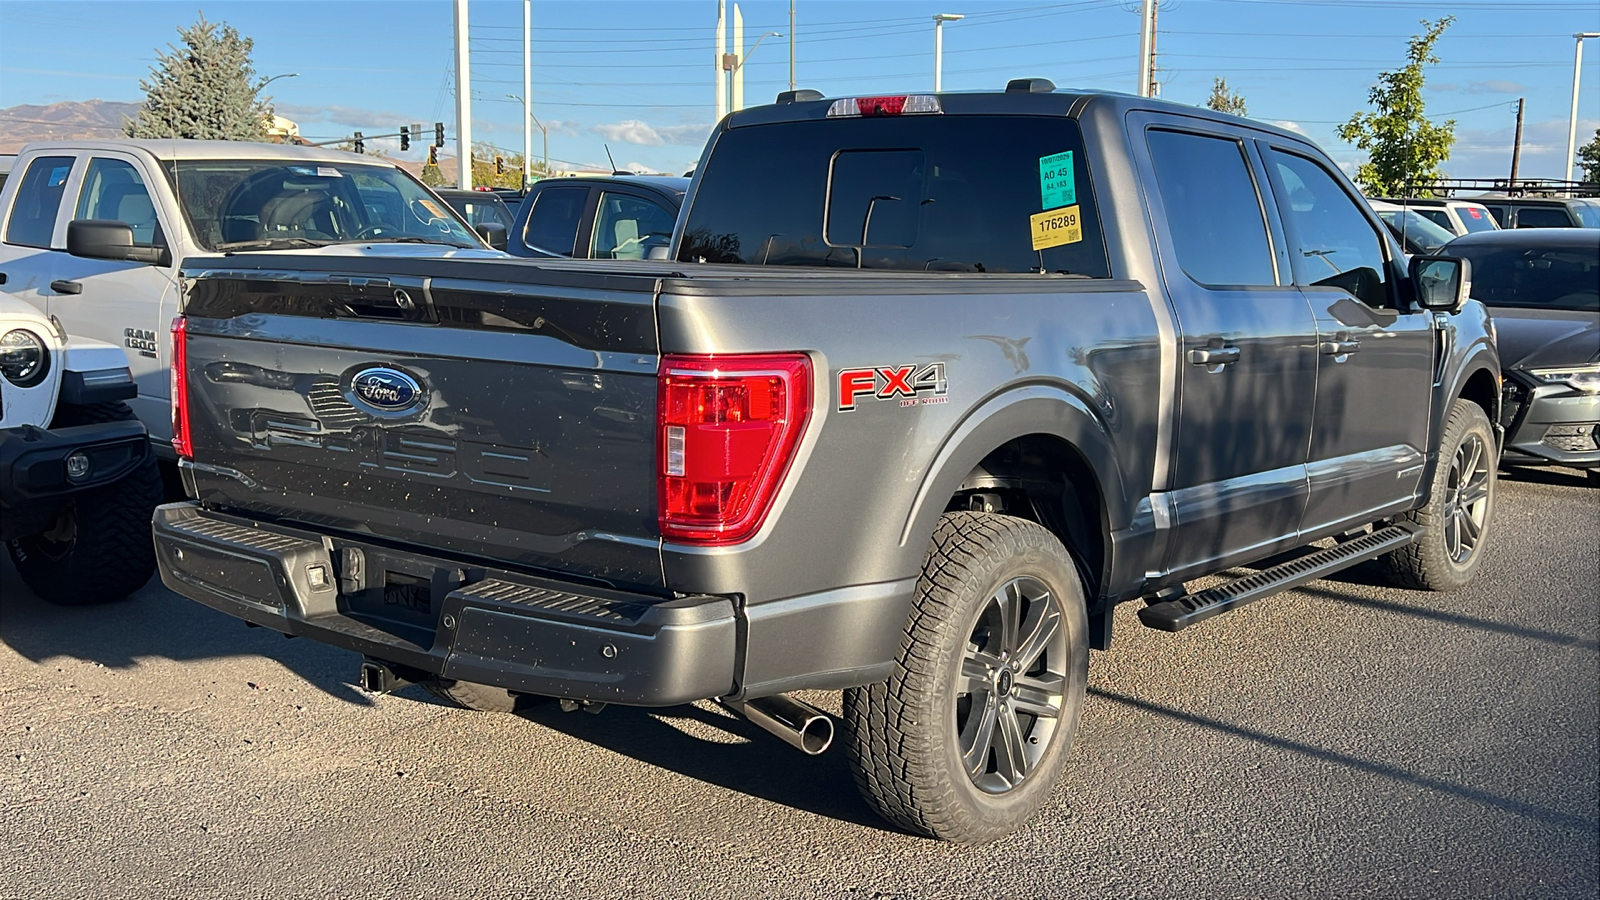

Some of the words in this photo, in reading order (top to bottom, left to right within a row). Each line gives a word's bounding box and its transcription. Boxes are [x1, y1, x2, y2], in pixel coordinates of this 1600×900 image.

[1057, 168, 1068, 177] 45
[1039, 214, 1076, 232] 176289
[124, 327, 156, 341] RAM
[124, 338, 156, 351] 1500
[363, 376, 401, 402] Ford
[837, 361, 949, 413] FX4
[899, 399, 919, 407] OFF
